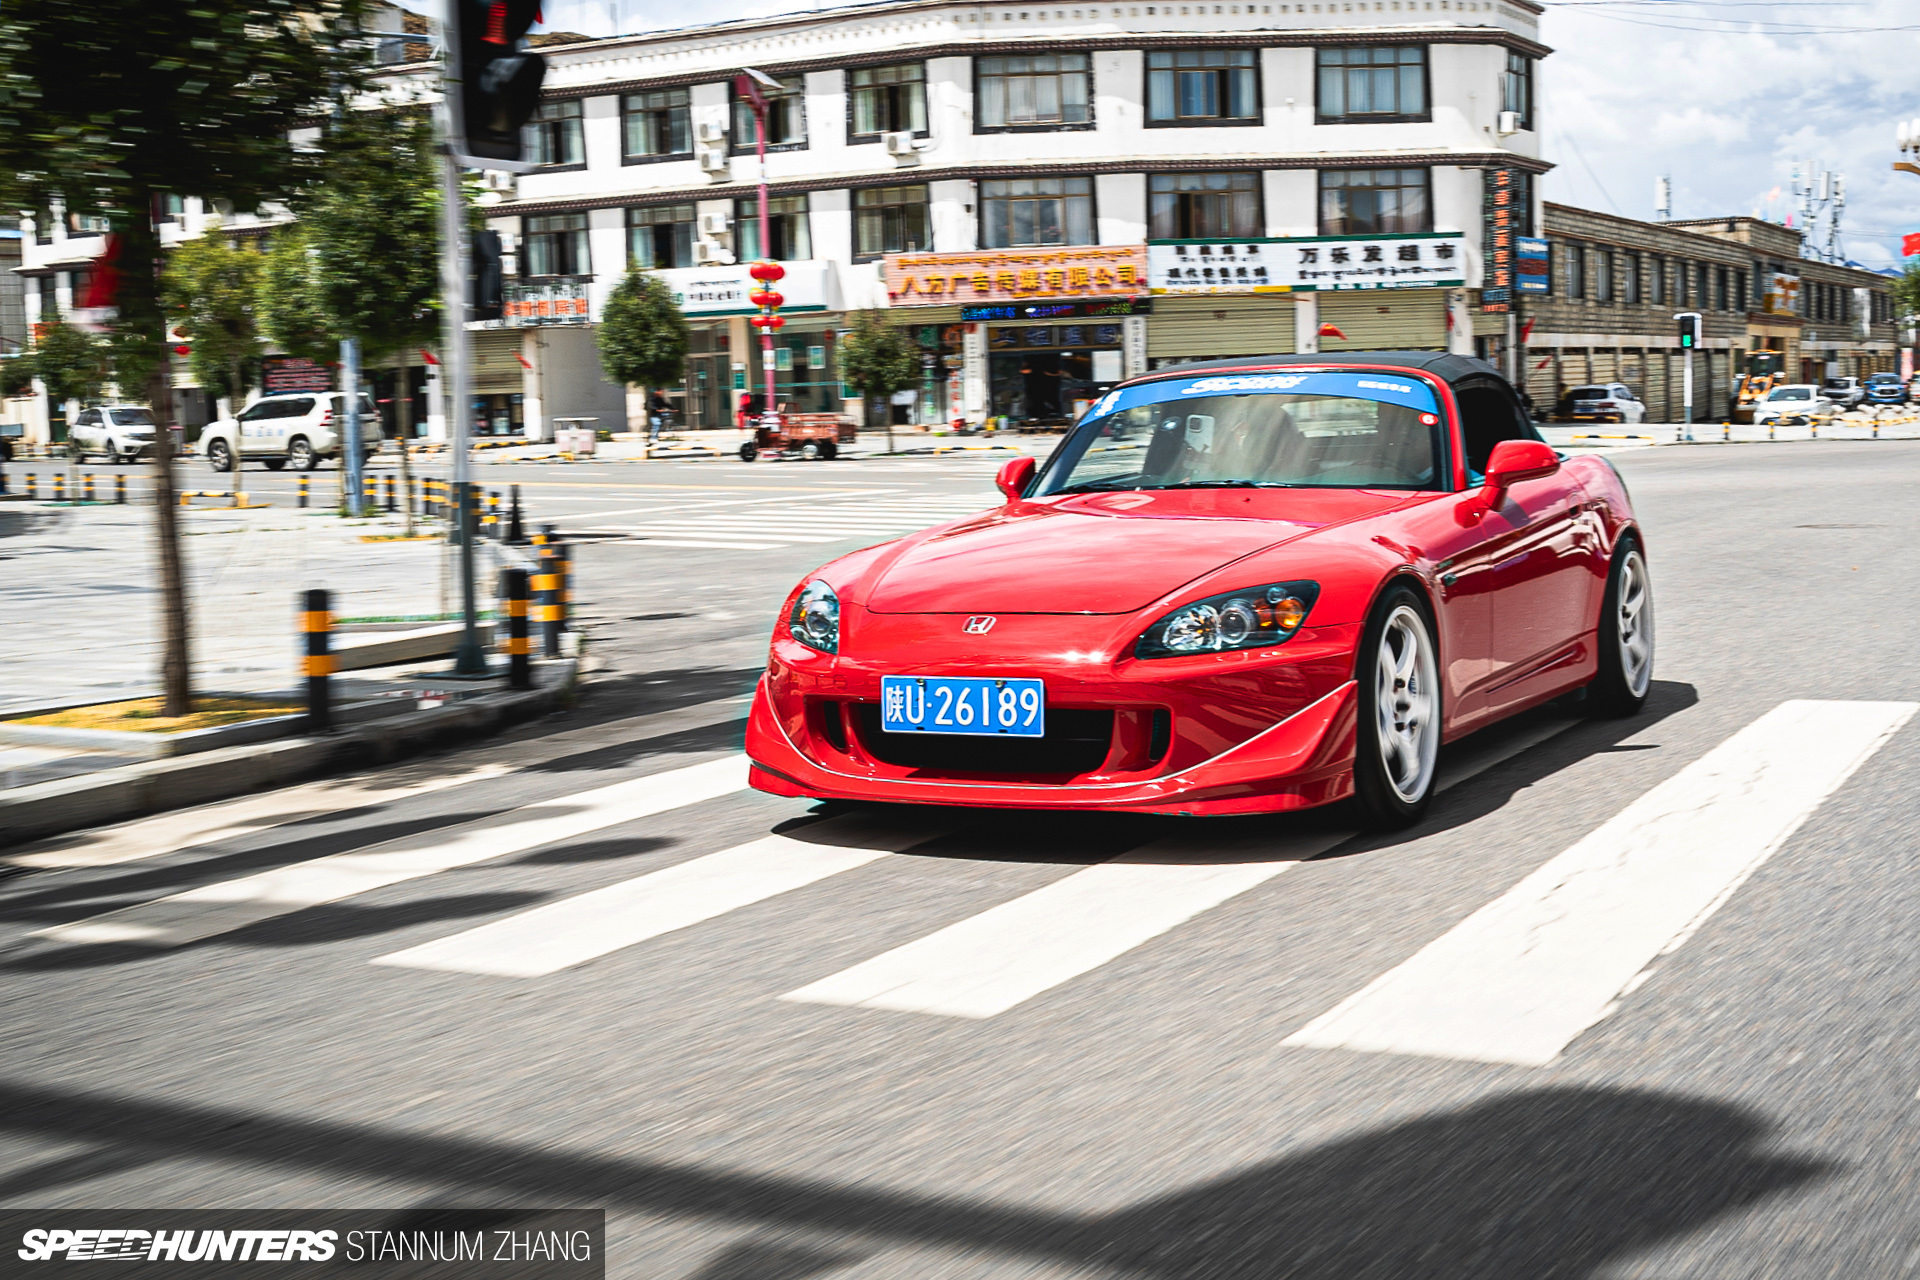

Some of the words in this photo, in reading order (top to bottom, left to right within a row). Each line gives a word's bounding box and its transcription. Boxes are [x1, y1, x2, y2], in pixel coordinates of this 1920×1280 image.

[1298, 243, 1456, 264] 万乐发超市
[899, 264, 1138, 295] 八方广告传媒有限公司
[1422, 415, 1434, 425] 6
